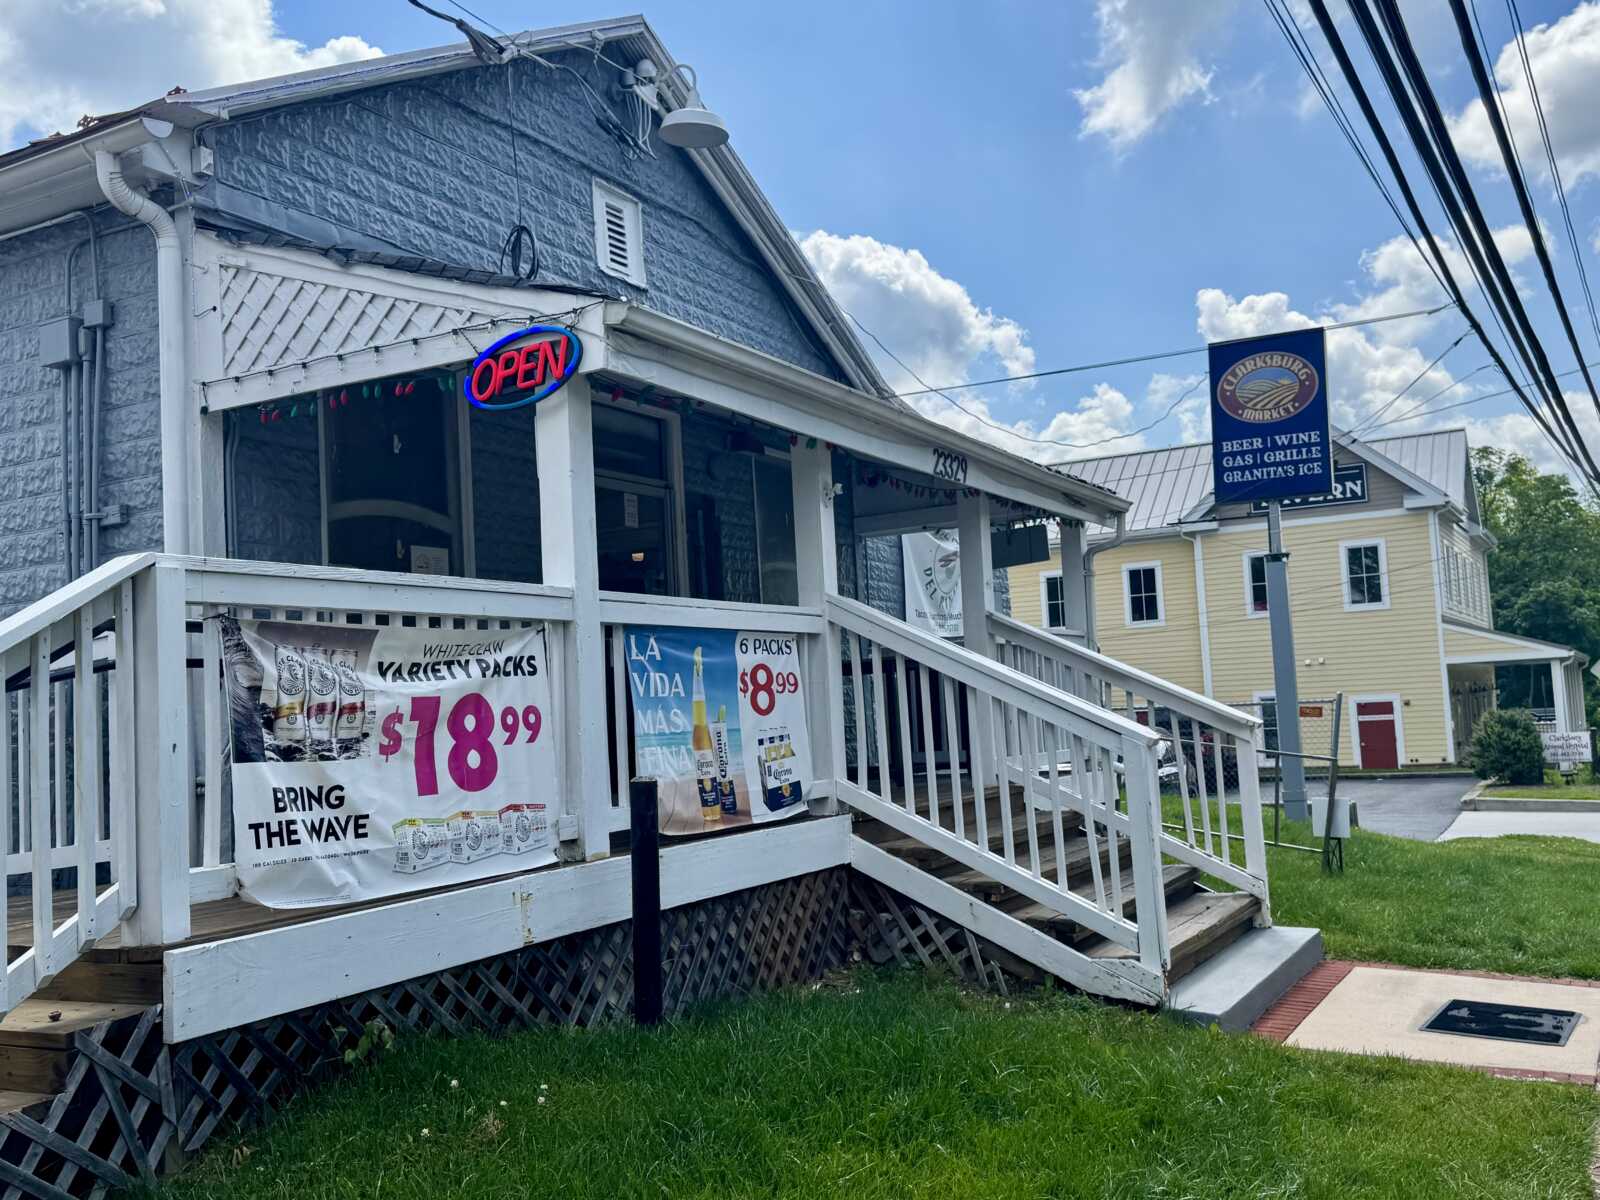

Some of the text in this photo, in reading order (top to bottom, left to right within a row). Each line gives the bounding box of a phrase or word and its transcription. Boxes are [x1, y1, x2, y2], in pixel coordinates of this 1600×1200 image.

[472, 335, 568, 401] OPEN
[1223, 354, 1311, 390] CLARKSBURG
[1242, 402, 1295, 421] MARKET
[1222, 431, 1321, 453] BEER WINE
[933, 448, 968, 483] 23329
[1222, 446, 1322, 467] GAS GRILLE
[1223, 462, 1323, 483] GRANITA'S ICE
[923, 567, 937, 600] DEL
[630, 634, 662, 661] LA
[739, 638, 749, 655] 6
[377, 655, 538, 683] VARIETY PACKS
[632, 672, 686, 698] VIDA
[637, 704, 684, 735] MÁS
[641, 745, 692, 772] FINA
[272, 784, 346, 814] BRING
[248, 814, 370, 850] THE WAVE
